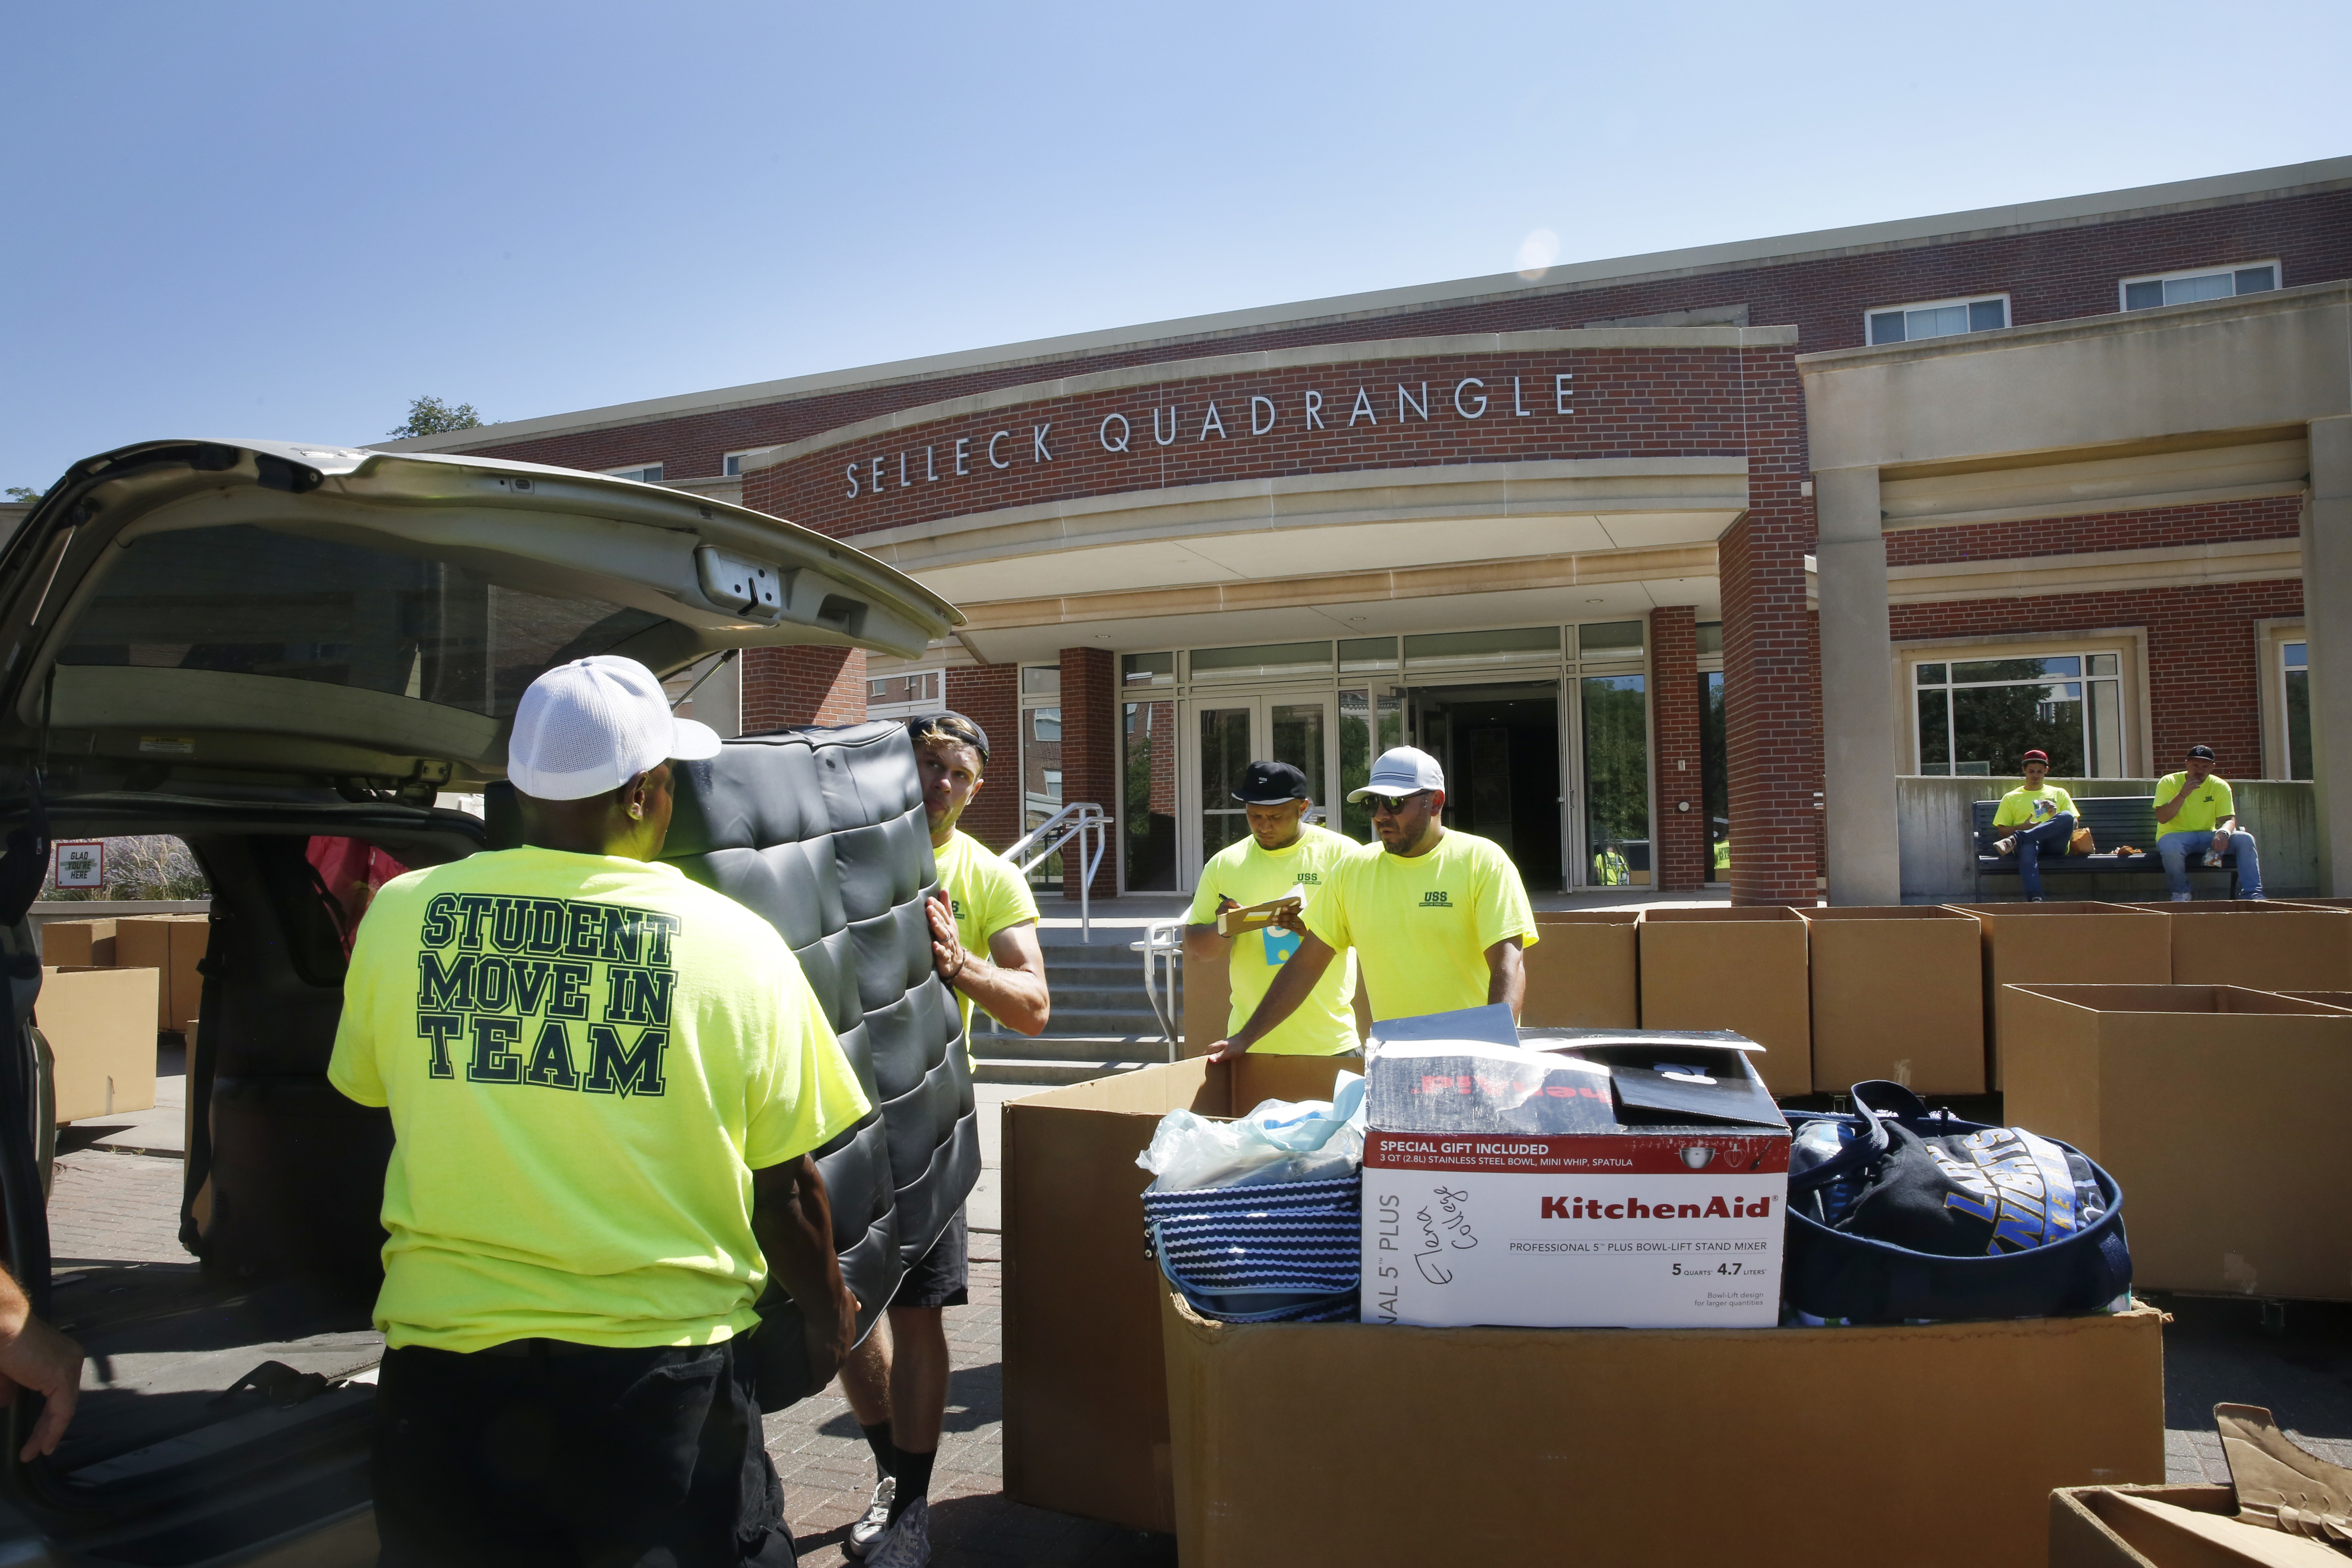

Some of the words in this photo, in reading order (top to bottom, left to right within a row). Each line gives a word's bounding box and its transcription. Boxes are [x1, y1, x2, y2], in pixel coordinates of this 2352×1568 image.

[846, 424, 1053, 498] SELLECK
[1100, 374, 1574, 453] QUADRANGLE
[68, 861, 91, 870] YOU'RE
[1424, 891, 1448, 902] USS
[421, 892, 682, 968] STUDENT
[417, 950, 593, 1021] MOVE
[603, 964, 679, 1029] IN
[416, 1011, 671, 1100] TEAM
[1380, 1140, 1437, 1153] SPECIAL
[1441, 1142, 1472, 1154] GIFT
[1476, 1143, 1549, 1155] INCLUDED
[1403, 1155, 1426, 1164] (2.8L)
[1428, 1156, 1476, 1164] STAINLESS
[1478, 1157, 1505, 1165] STEEL
[1508, 1158, 1537, 1167] BOWL,
[1563, 1158, 1590, 1167] WHIP,
[1379, 1195, 1399, 1251] PLUS
[1433, 1186, 1478, 1249] College
[1510, 1242, 1590, 1252] PROFESSIONAL
[1608, 1243, 1633, 1251] PLUS
[1695, 1242, 1731, 1251] STAND
[1735, 1242, 1767, 1250] MIXER
[1672, 1263, 1682, 1276] 5
[1717, 1263, 1742, 1275] 4.7
